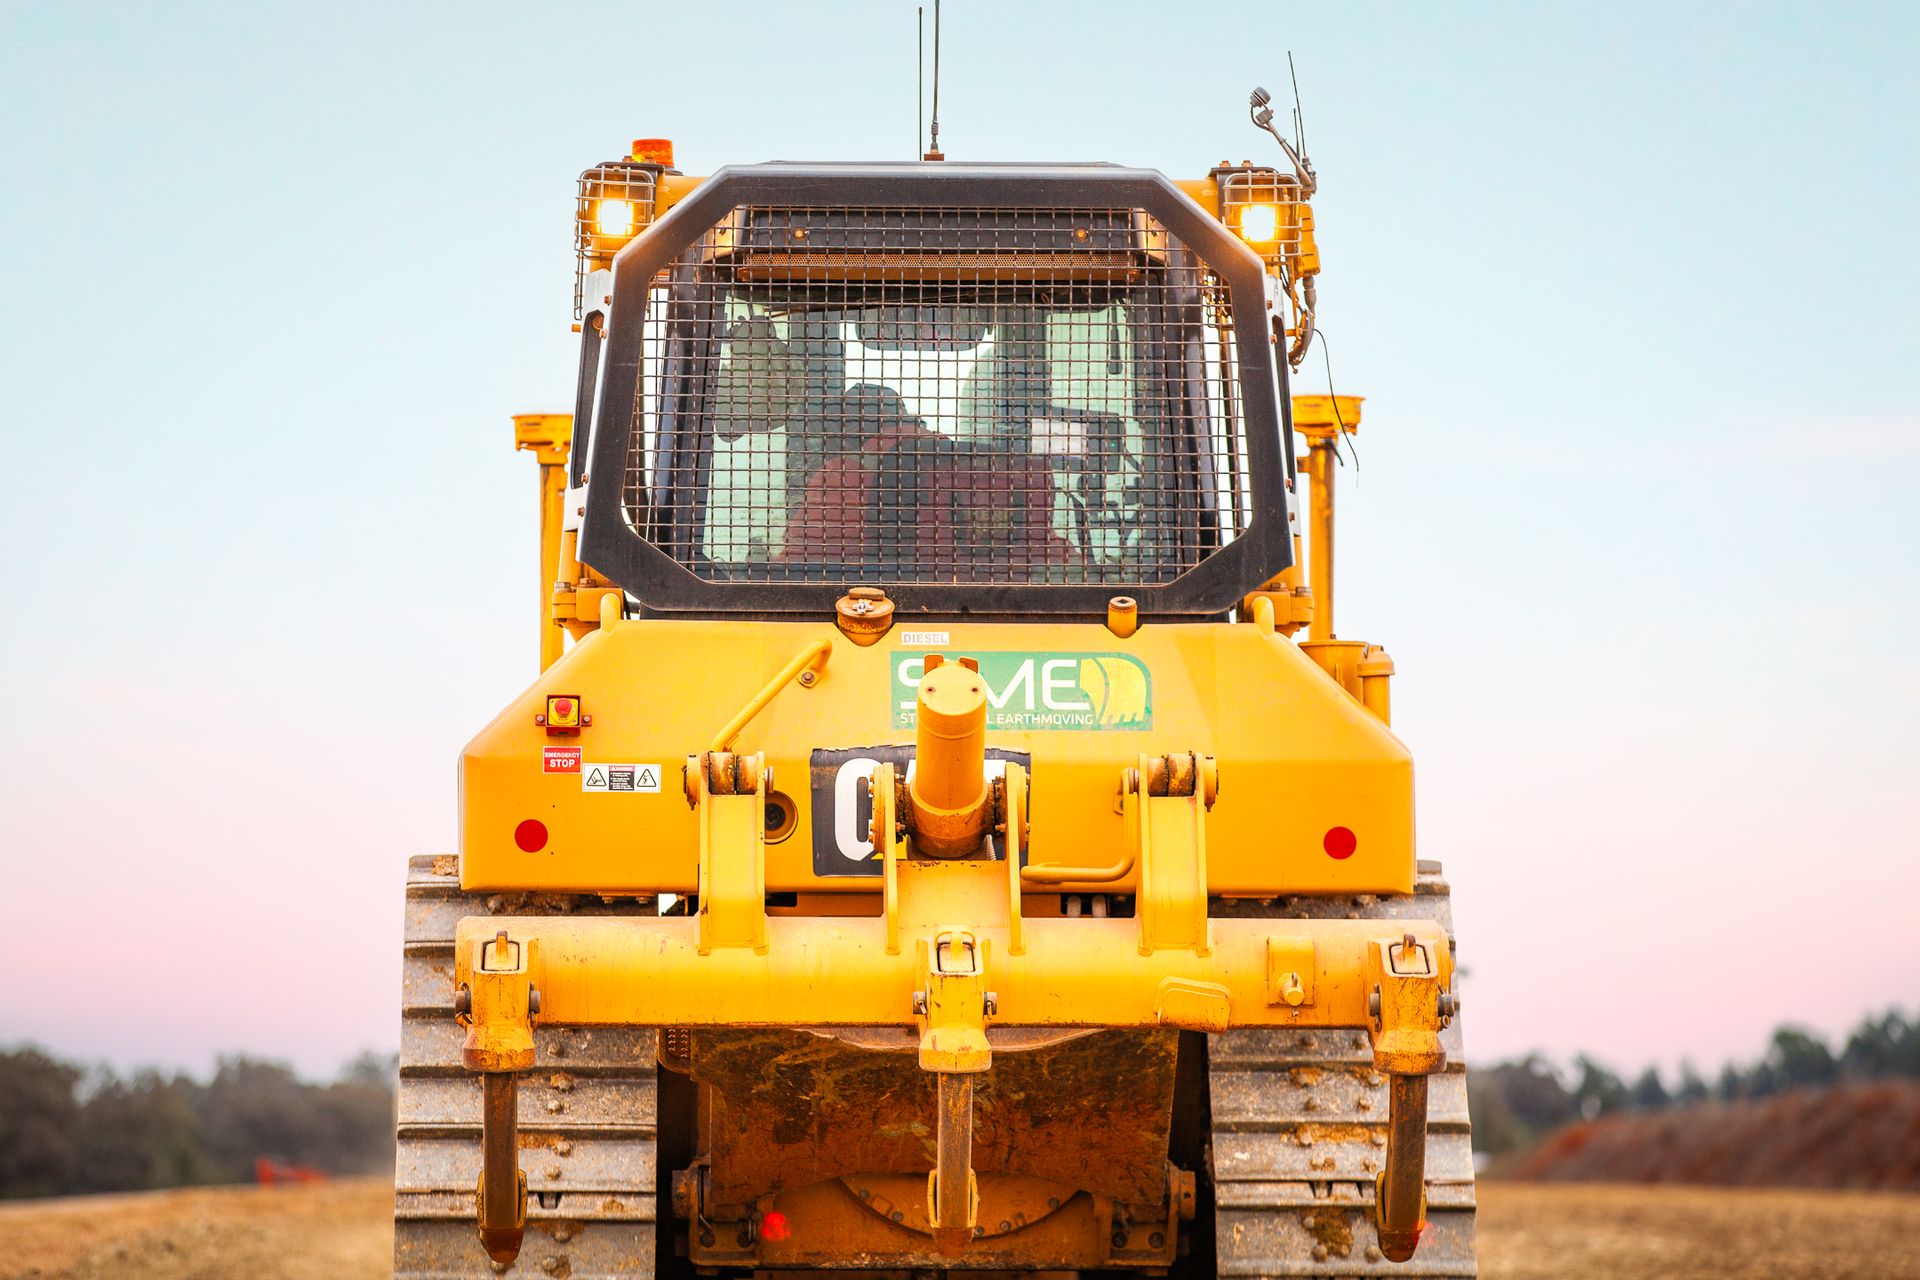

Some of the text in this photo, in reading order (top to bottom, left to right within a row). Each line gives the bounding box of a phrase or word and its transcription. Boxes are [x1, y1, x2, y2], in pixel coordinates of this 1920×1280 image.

[903, 633, 947, 643] DIESEL
[997, 713, 1094, 725] EARTHMOVING
[550, 759, 575, 768] STOP
